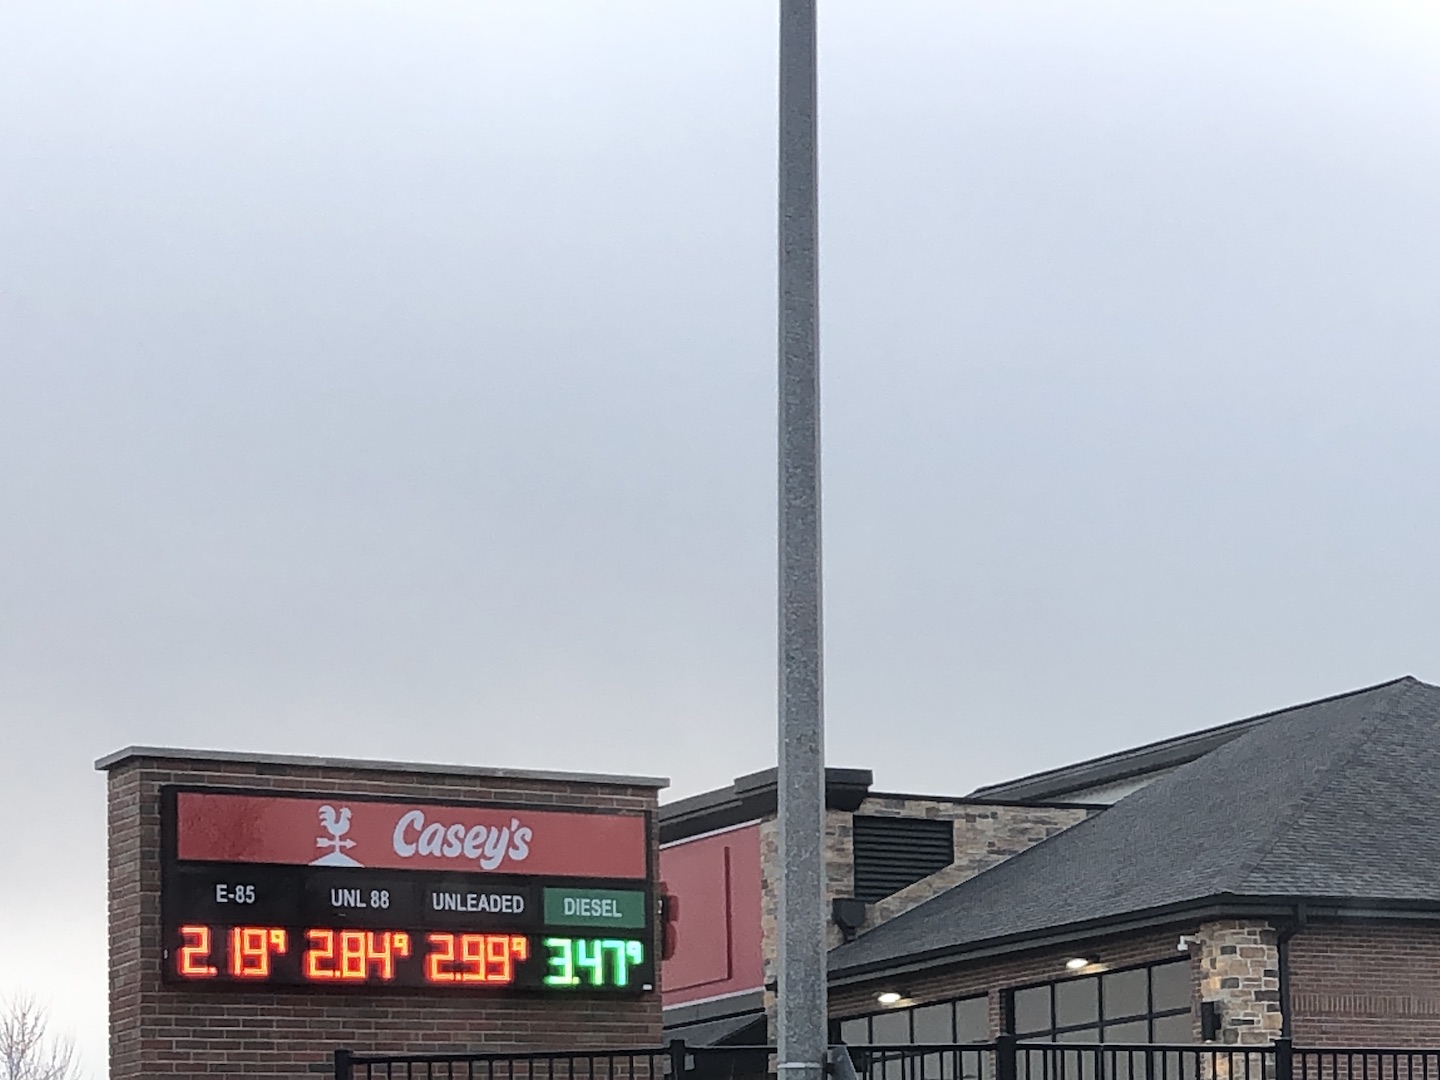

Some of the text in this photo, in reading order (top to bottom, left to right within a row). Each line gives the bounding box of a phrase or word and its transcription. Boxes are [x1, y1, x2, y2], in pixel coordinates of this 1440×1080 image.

[393, 810, 533, 870] Casey's
[216, 884, 255, 904] E-85
[331, 889, 390, 909] UNL 88
[432, 892, 524, 914] UNLEADED
[564, 897, 622, 918] DIESEL
